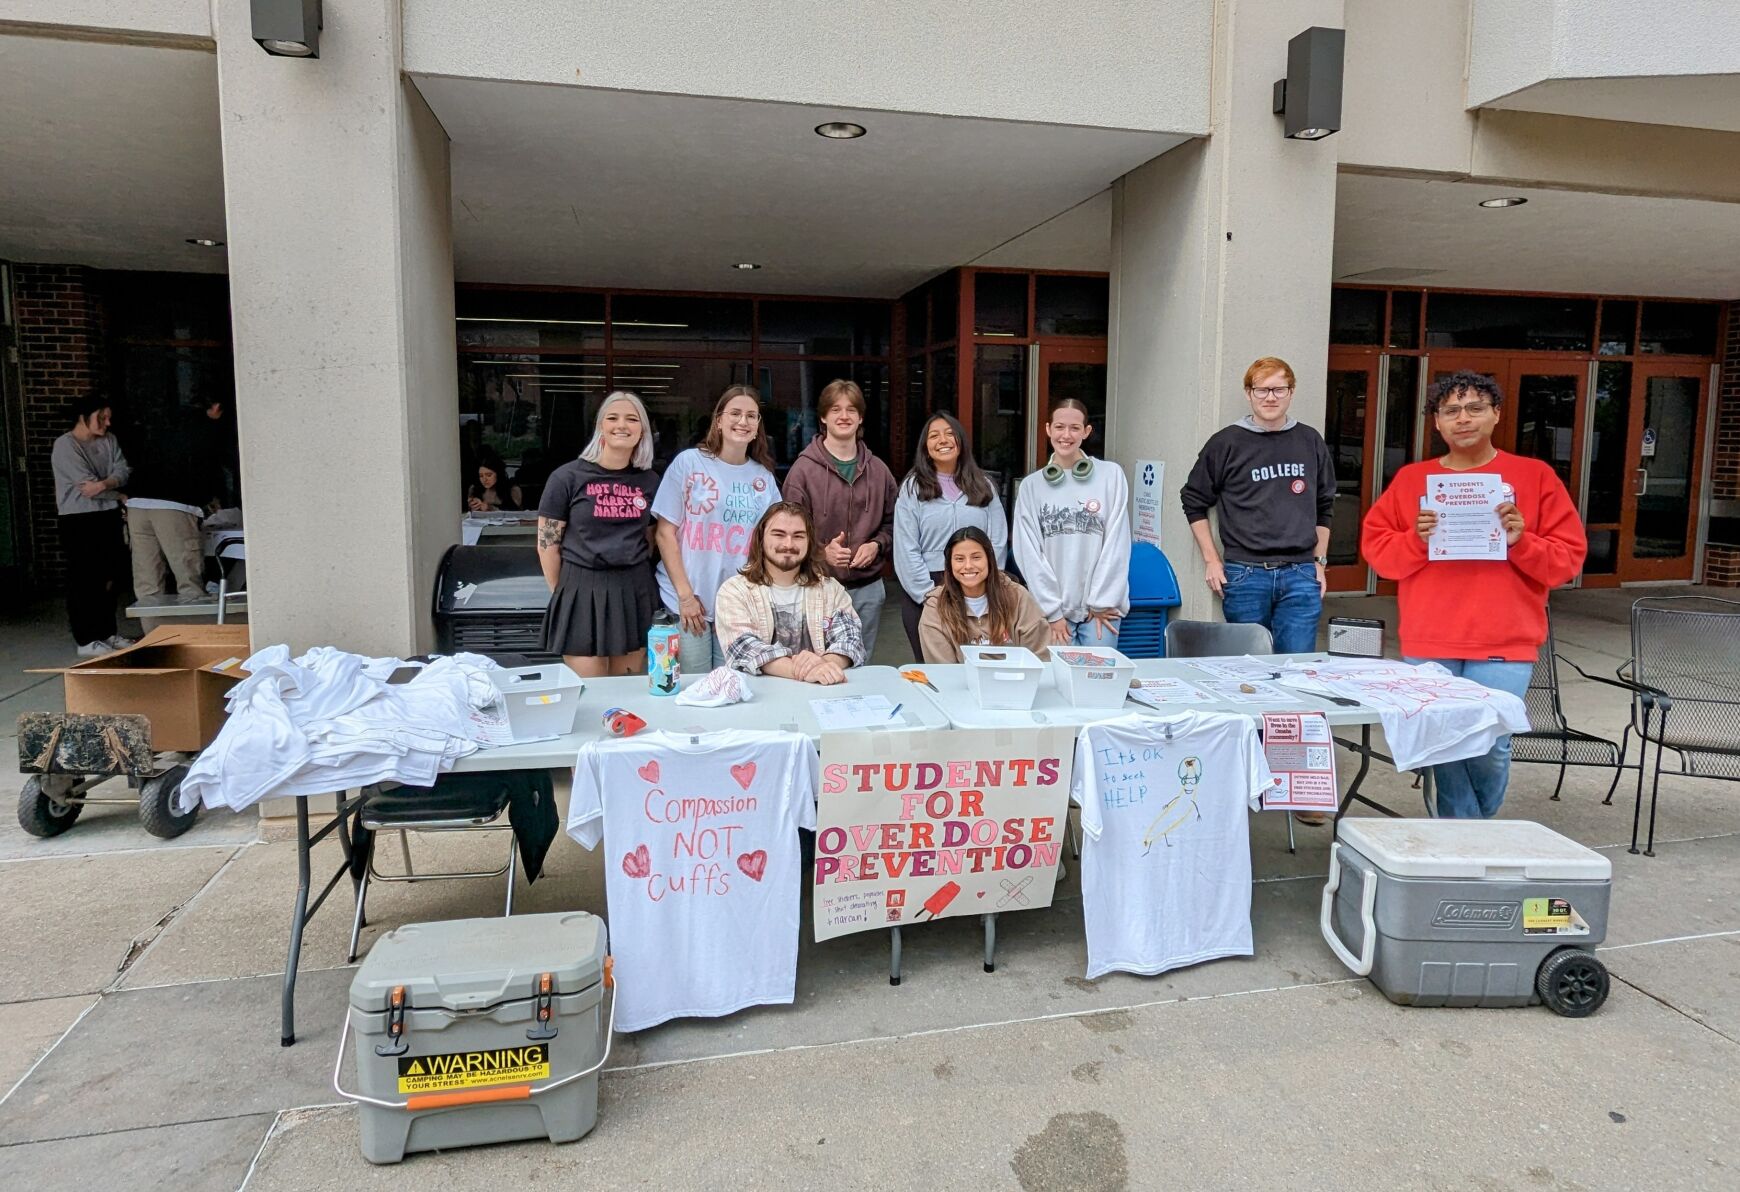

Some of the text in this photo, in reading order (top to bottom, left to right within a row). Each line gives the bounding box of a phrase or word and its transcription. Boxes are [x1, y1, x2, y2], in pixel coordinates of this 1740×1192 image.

[1252, 463, 1305, 482] COLLEGE
[586, 483, 643, 497] HOT GIRLS
[596, 494, 633, 506] CARRY
[726, 494, 760, 511] GIRLS
[594, 504, 641, 518] NARCAN
[723, 508, 758, 524] CARRY
[1143, 747, 1165, 762] OK
[823, 758, 1060, 793] STUDENTS
[1104, 772, 1116, 783] to
[899, 790, 984, 820] FOR
[1104, 784, 1147, 810] HELP
[645, 788, 757, 830] Compassion
[674, 825, 744, 860] NOT
[818, 816, 1054, 854] OVERDOSE
[816, 842, 1062, 885] PREVENTION
[1443, 904, 1498, 919] Coleman
[426, 1046, 542, 1074] WARNING
[406, 1075, 443, 1083] CAMPING
[480, 1066, 529, 1076] HAZARDOUS
